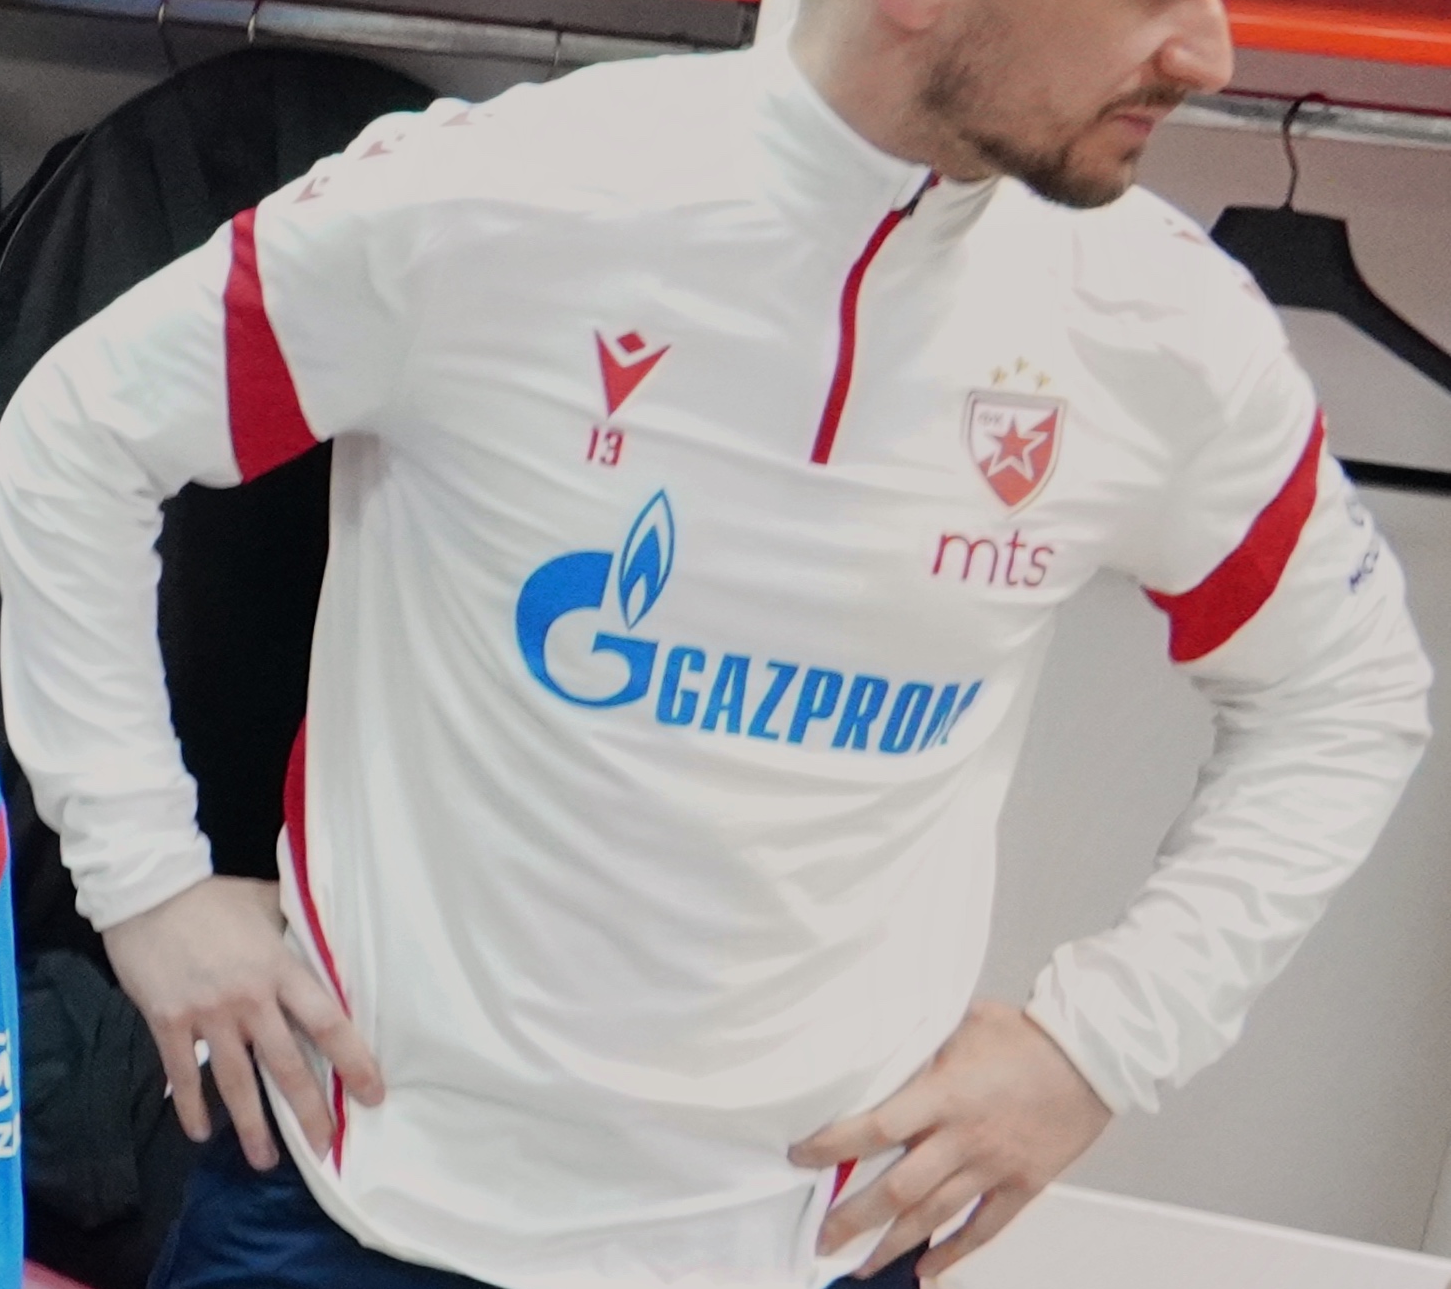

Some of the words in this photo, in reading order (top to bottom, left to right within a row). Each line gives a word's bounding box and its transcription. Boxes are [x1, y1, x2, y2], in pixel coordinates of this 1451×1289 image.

[584, 428, 624, 468] 13
[931, 522, 1055, 588] mts
[656, 645, 984, 755] GAZPROM
